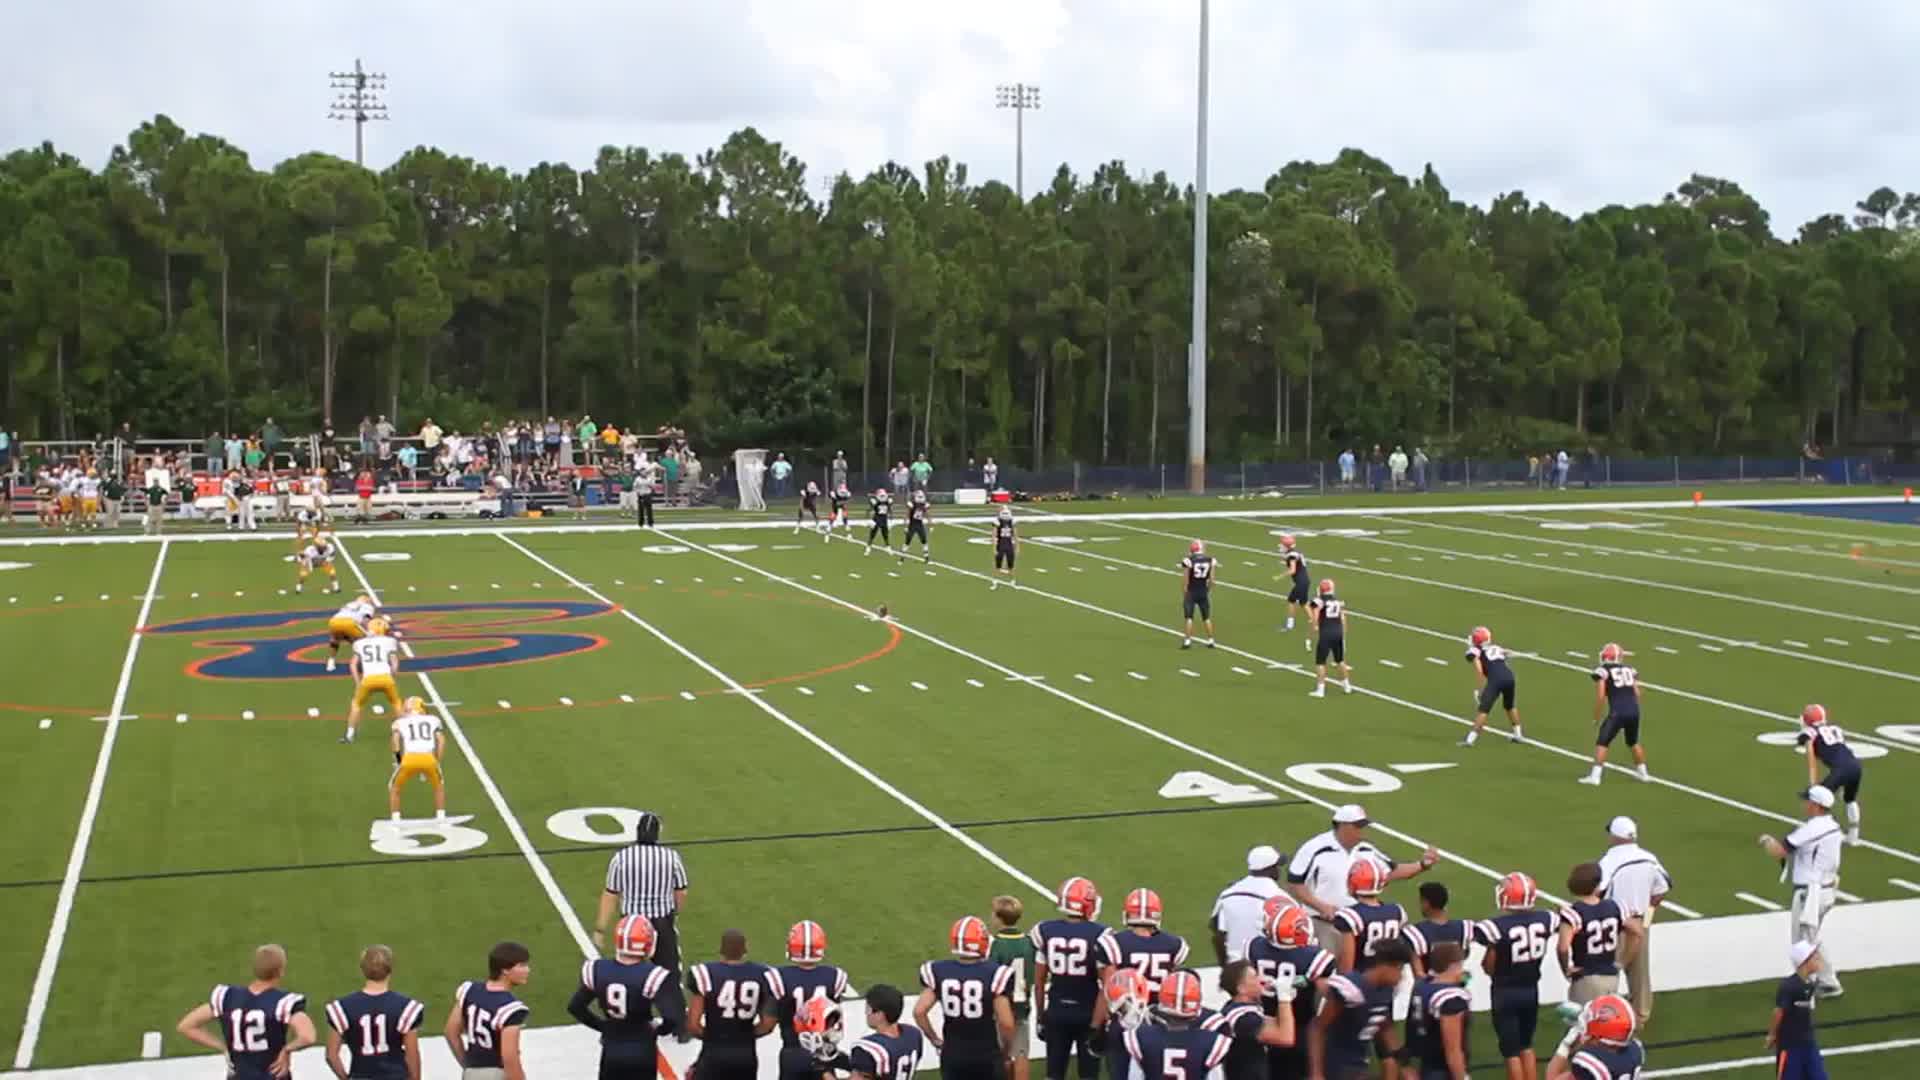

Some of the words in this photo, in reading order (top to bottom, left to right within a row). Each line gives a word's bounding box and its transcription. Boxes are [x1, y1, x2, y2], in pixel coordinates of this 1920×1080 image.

[1193, 562, 1211, 578] 57
[362, 644, 384, 662] 51
[1610, 667, 1634, 688] 50
[407, 720, 432, 741] 10
[1508, 922, 1547, 963] 26
[1586, 917, 1619, 955] 23
[1047, 936, 1088, 977] 62
[1130, 952, 1171, 992] 75
[606, 982, 627, 1019] 9
[717, 979, 760, 1019] 49
[941, 978, 984, 1019] 68
[231, 1008, 269, 1051] 12
[359, 1013, 390, 1055] 11
[466, 1003, 493, 1049] 15
[1163, 1048, 1187, 1080] 5
